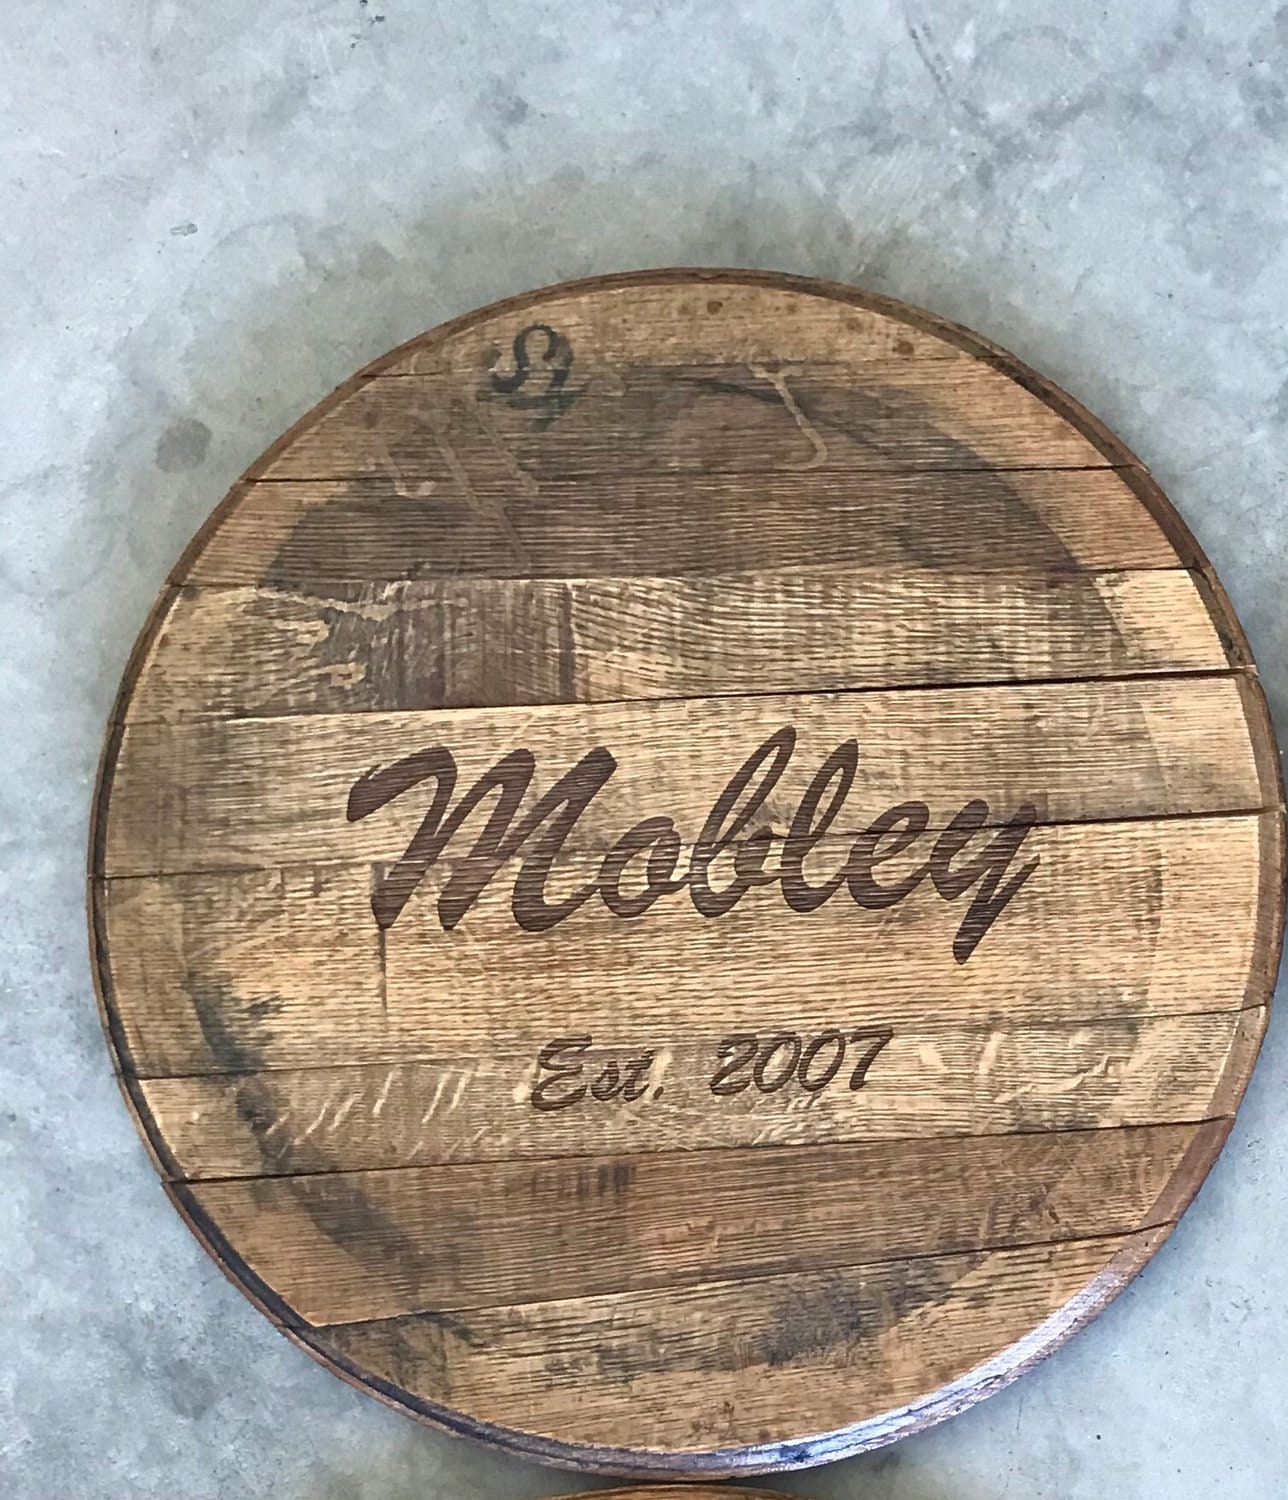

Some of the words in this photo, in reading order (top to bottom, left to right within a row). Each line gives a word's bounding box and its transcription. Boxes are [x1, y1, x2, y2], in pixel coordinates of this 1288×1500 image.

[346, 725, 1041, 965] Mobley
[530, 1035, 665, 1112] Est.
[709, 1024, 893, 1096] 2007
